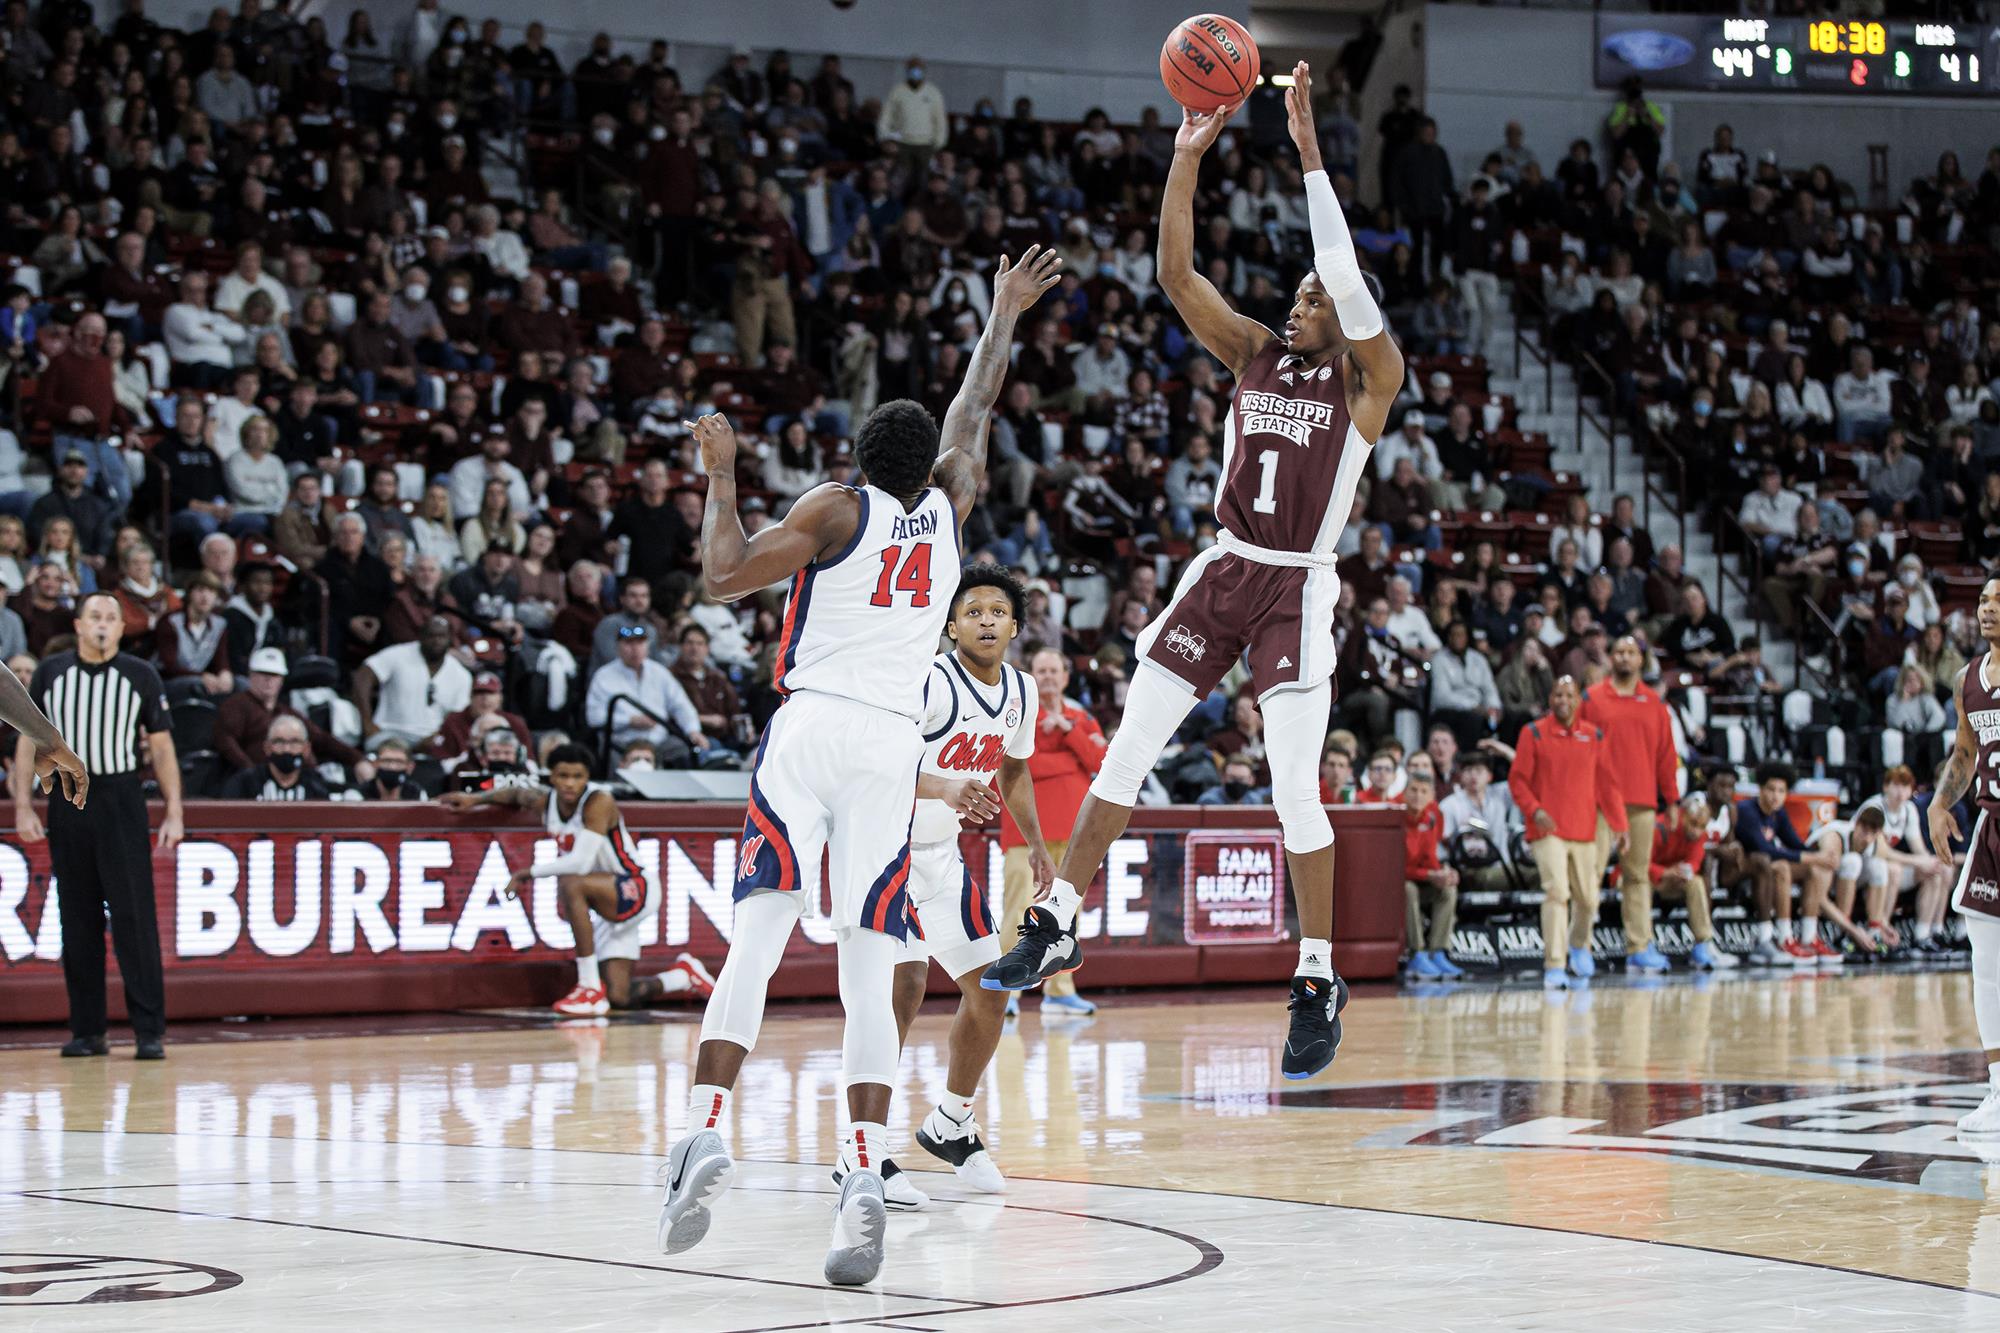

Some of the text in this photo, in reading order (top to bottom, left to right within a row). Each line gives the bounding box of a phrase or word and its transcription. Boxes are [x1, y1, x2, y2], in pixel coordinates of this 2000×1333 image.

[1712, 47, 1753, 77] 44
[1939, 53, 1979, 82] 41
[1240, 393, 1333, 426] MISSISSIPPI
[1251, 417, 1299, 440] STATE
[1253, 449, 1280, 515] 1
[891, 509, 938, 541] FAGAN
[869, 542, 933, 608] 14
[1173, 634, 1200, 654] STATE
